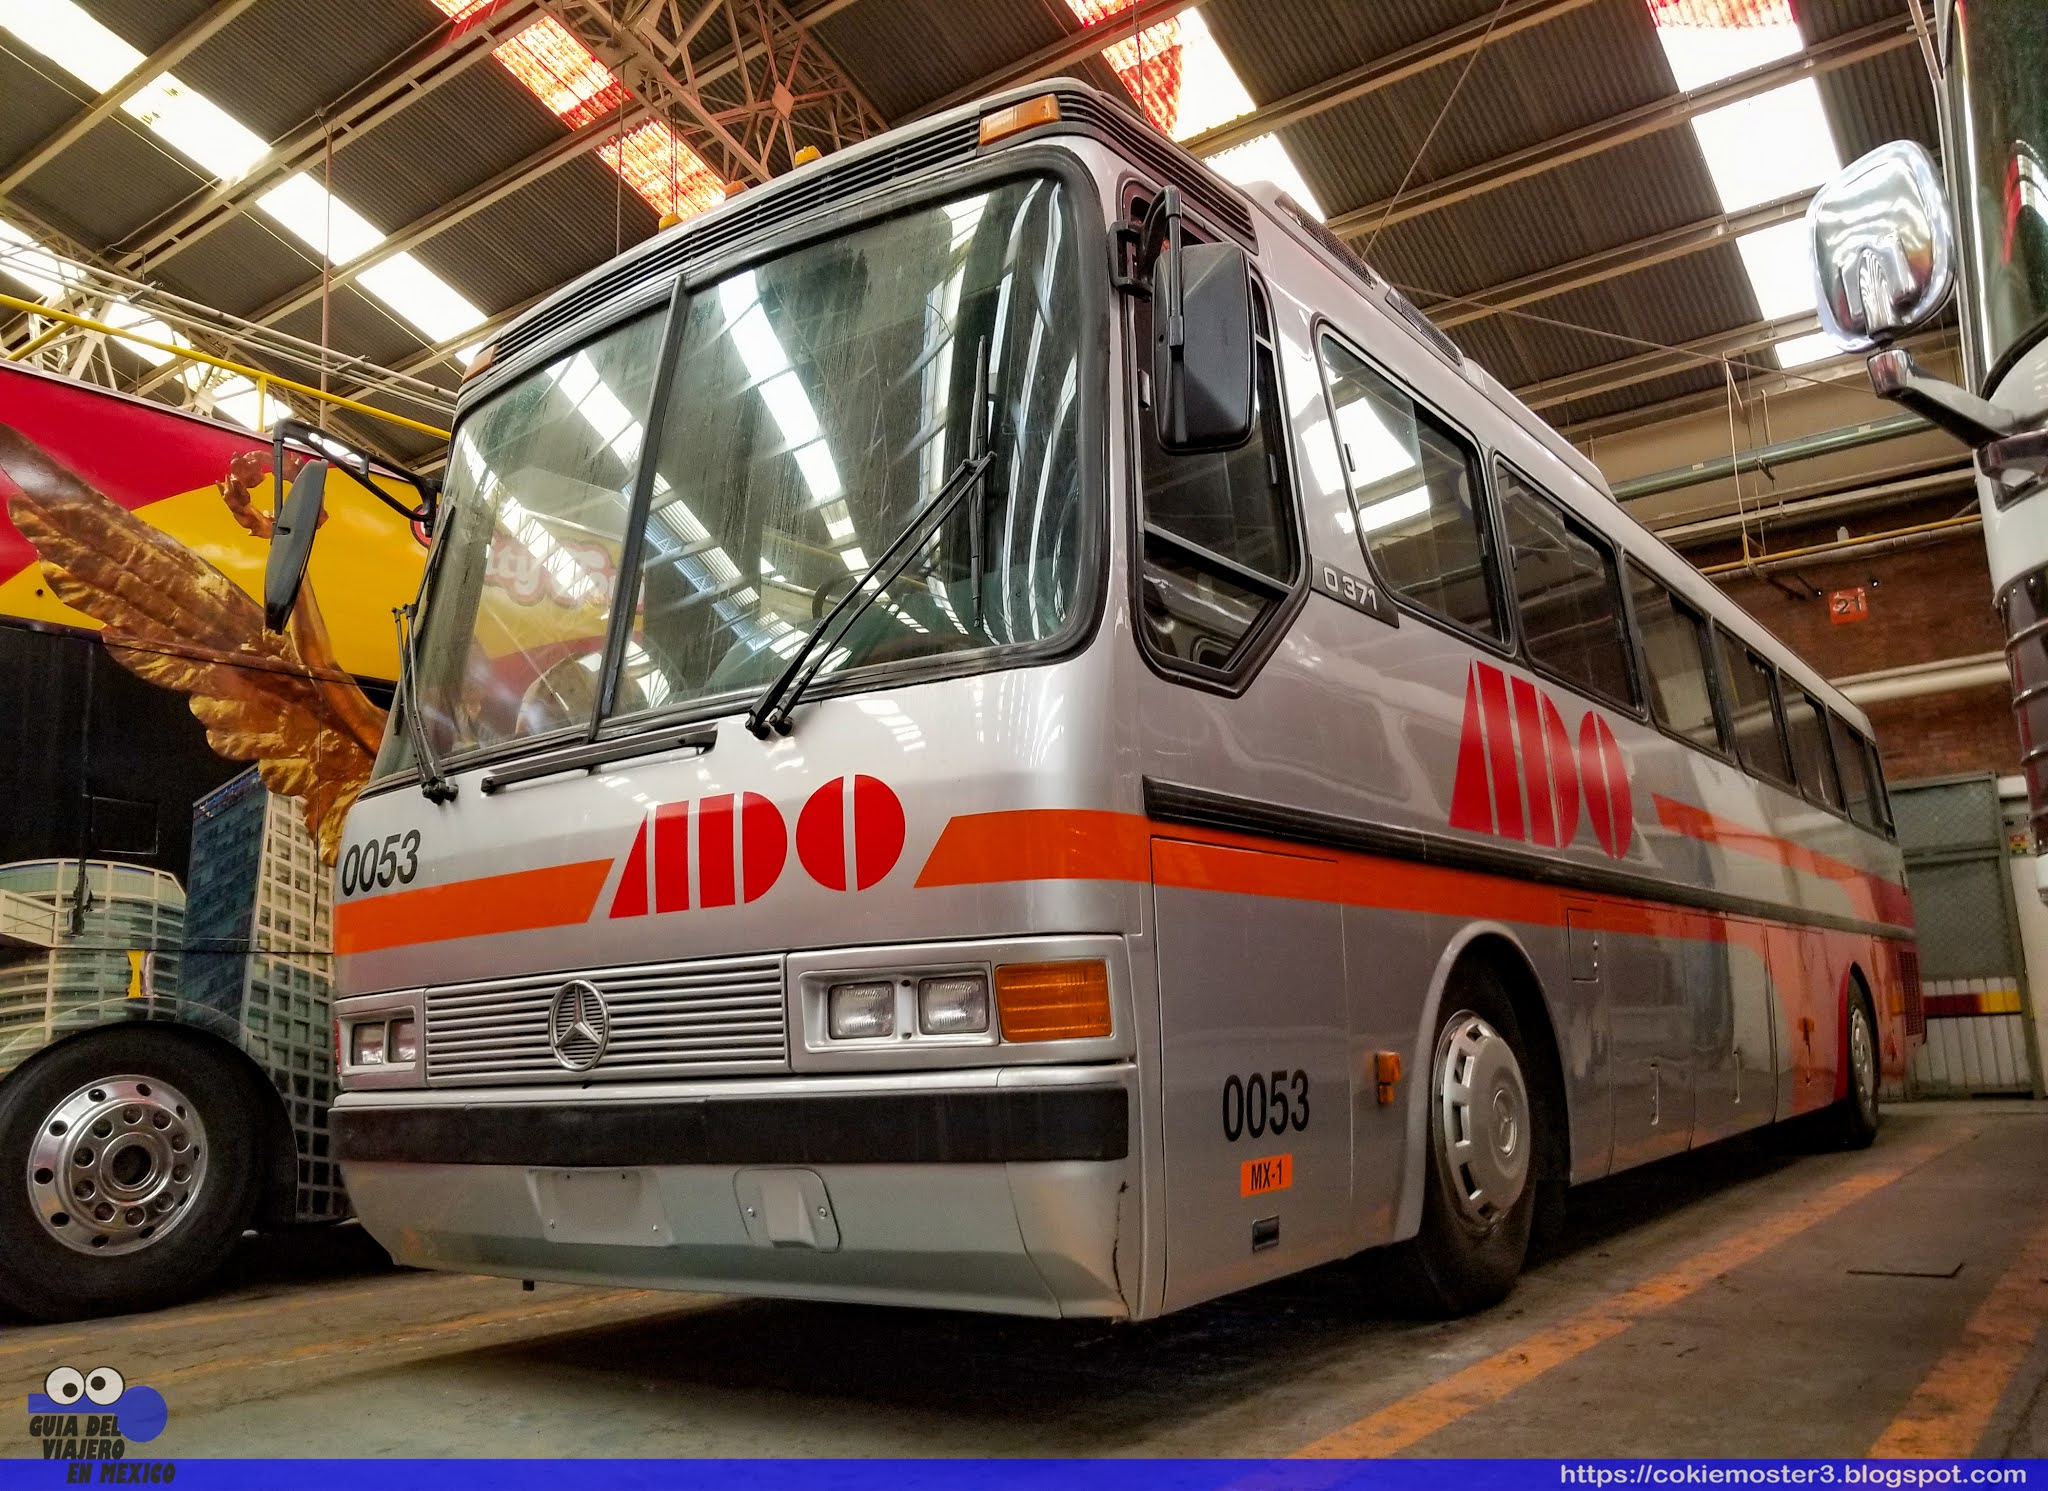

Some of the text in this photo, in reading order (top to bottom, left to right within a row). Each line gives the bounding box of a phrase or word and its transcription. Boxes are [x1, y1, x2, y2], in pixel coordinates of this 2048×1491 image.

[1342, 575, 1378, 611] 371
[1835, 596, 1860, 615] 21
[1448, 658, 1633, 861] ADO
[342, 829, 421, 896] 0053
[609, 774, 906, 919] ADO
[1222, 1069, 1310, 1142] 0053
[1250, 1159, 1283, 1191] MX-1
